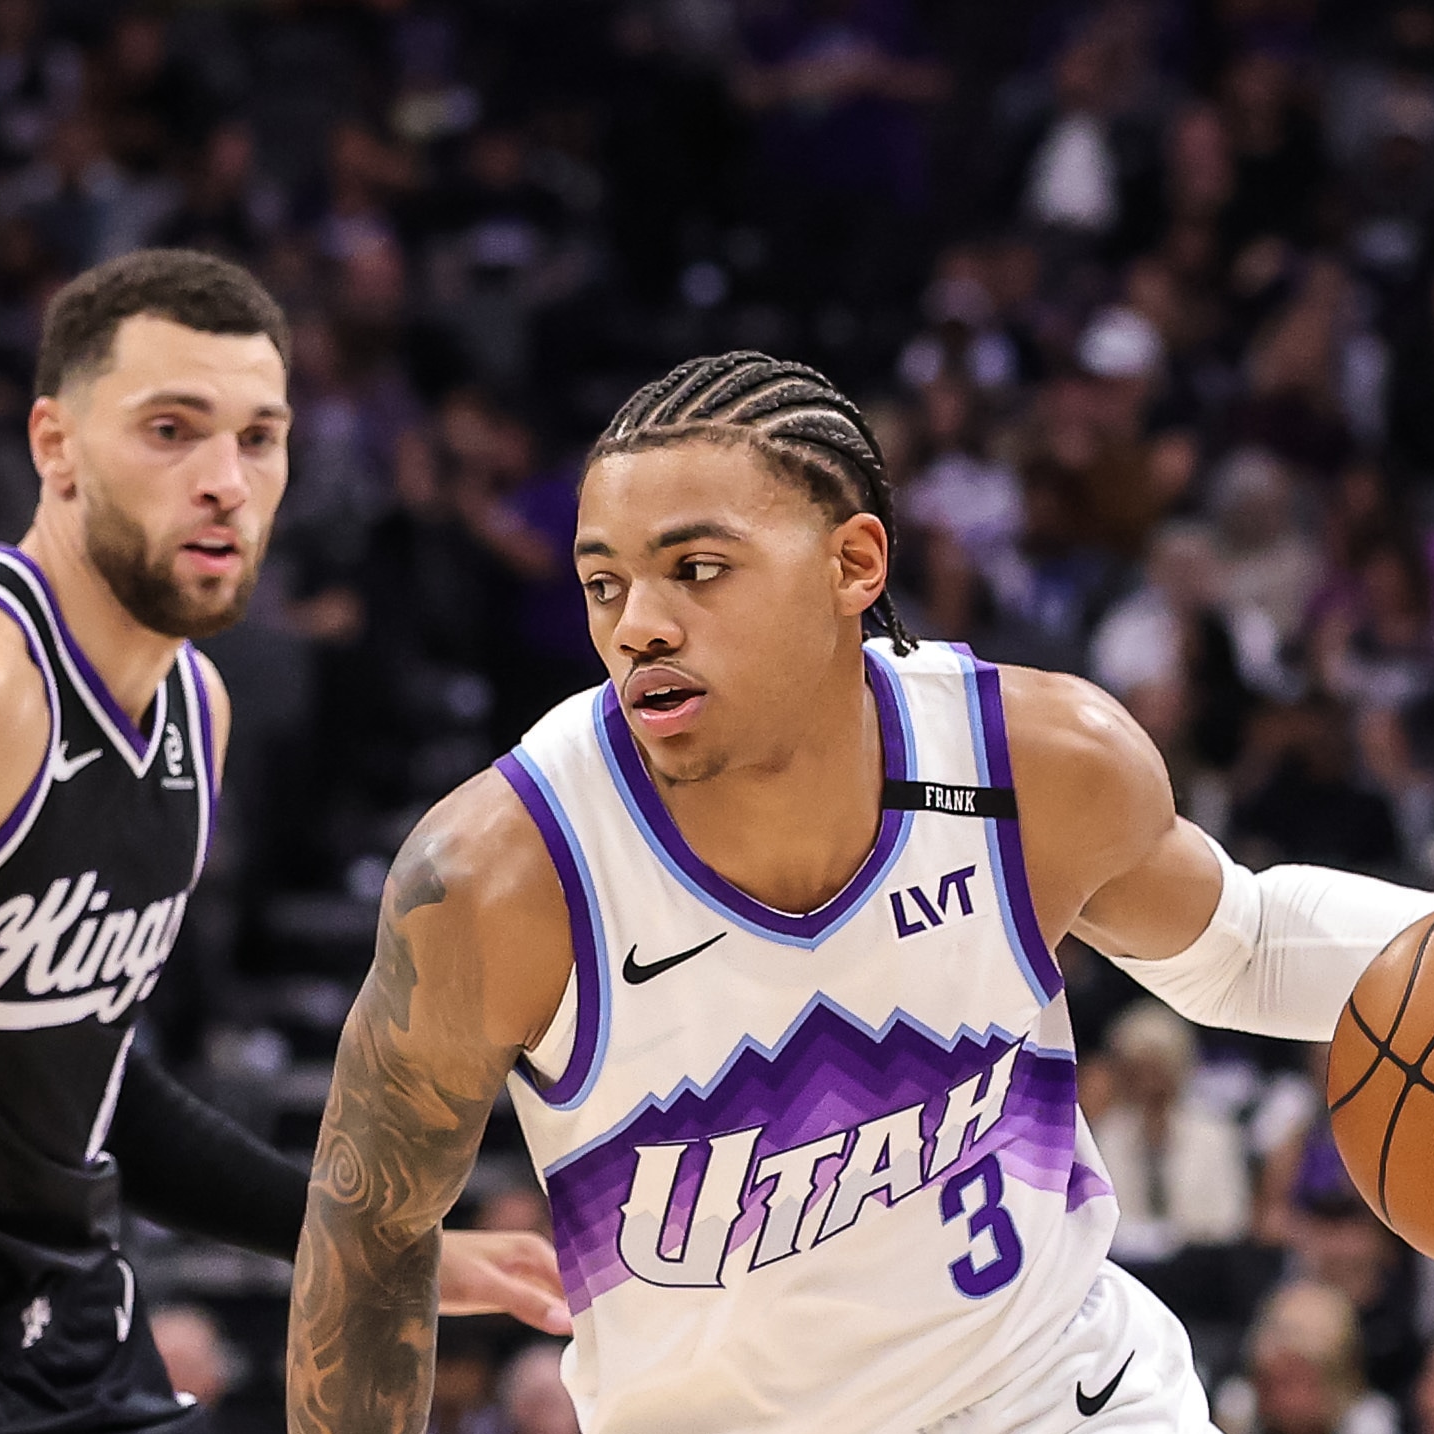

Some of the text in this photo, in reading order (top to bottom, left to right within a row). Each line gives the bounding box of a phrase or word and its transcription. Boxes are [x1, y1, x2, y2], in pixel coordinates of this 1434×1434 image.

[925, 785, 977, 812] FRANK
[889, 864, 977, 939] LVT
[616, 1032, 1029, 1290] UTAH
[939, 1151, 1024, 1301] 3
